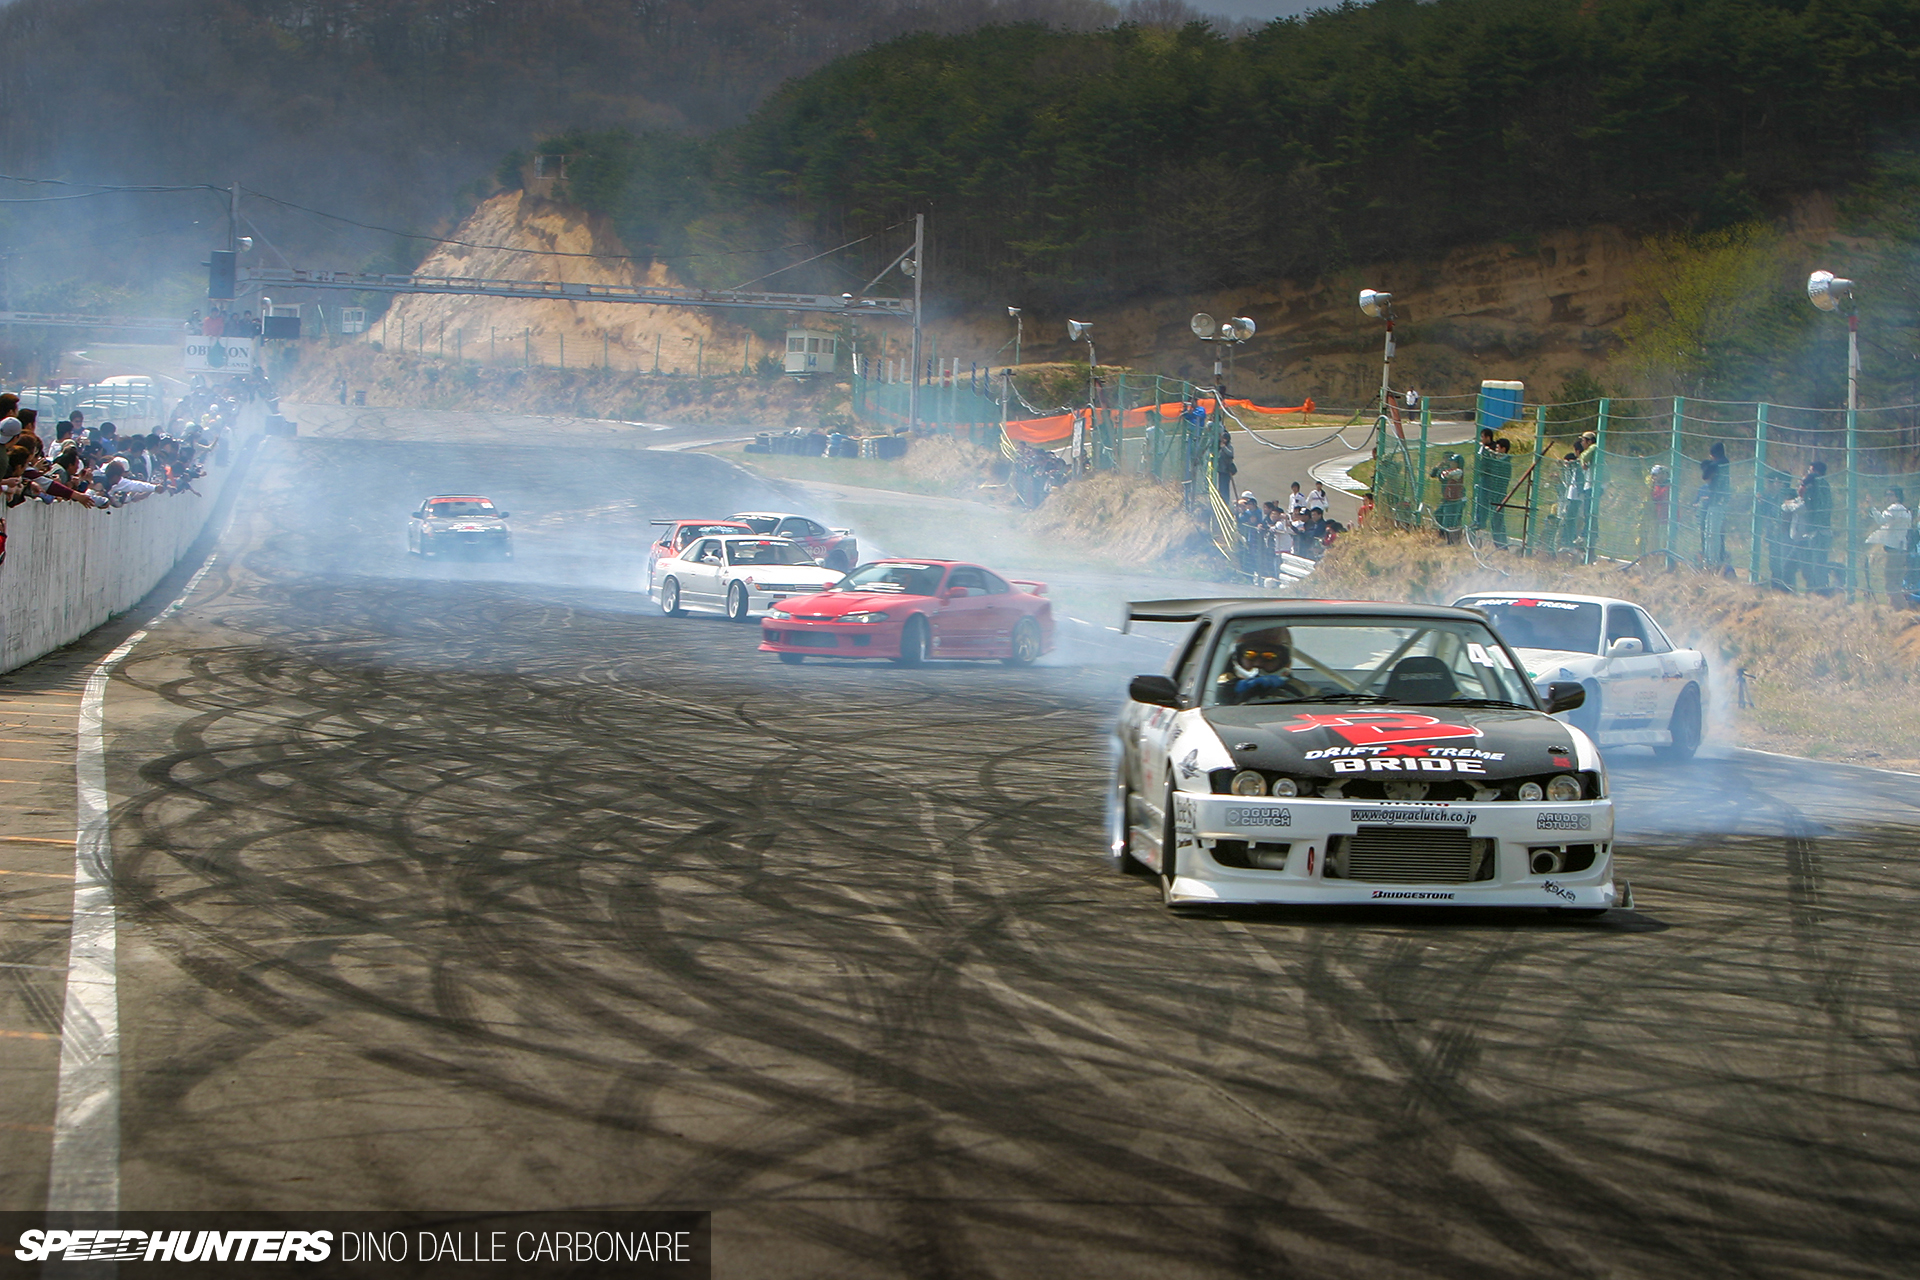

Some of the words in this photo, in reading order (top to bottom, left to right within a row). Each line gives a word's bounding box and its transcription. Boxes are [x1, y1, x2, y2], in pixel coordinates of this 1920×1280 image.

[1329, 757, 1487, 775] BRIDE
[1240, 807, 1291, 818] OGURA
[1351, 809, 1477, 825] www.oguraclutch.co.jp
[1240, 817, 1291, 827] CLUTCH
[1371, 890, 1455, 900] BRIDGESTONE
